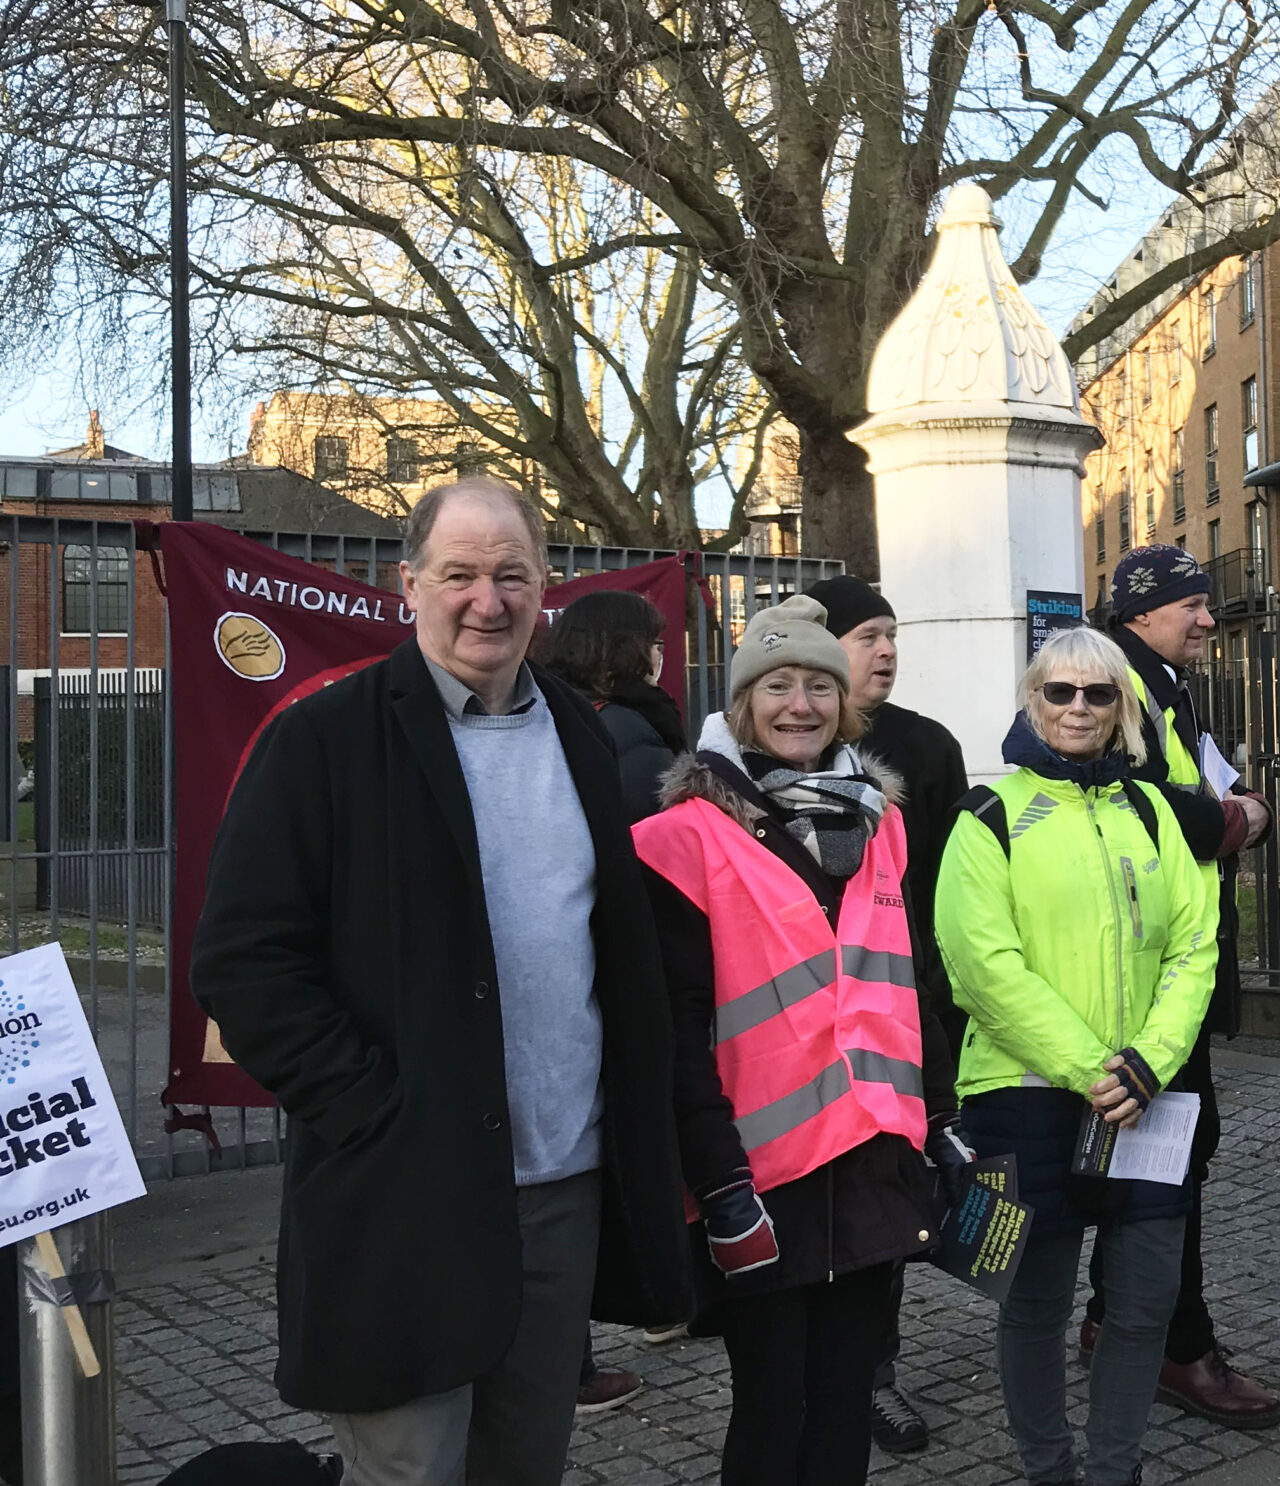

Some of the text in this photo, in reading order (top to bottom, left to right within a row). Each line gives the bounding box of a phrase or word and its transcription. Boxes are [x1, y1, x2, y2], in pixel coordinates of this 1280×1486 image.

[226, 568, 386, 622] NATIONAL
[1027, 598, 1081, 618] Striking
[1032, 615, 1047, 627] for
[983, 1201, 1011, 1271] in danger of
[990, 1205, 1017, 1273] colleges are
[999, 1208, 1026, 1271] Sixth form
